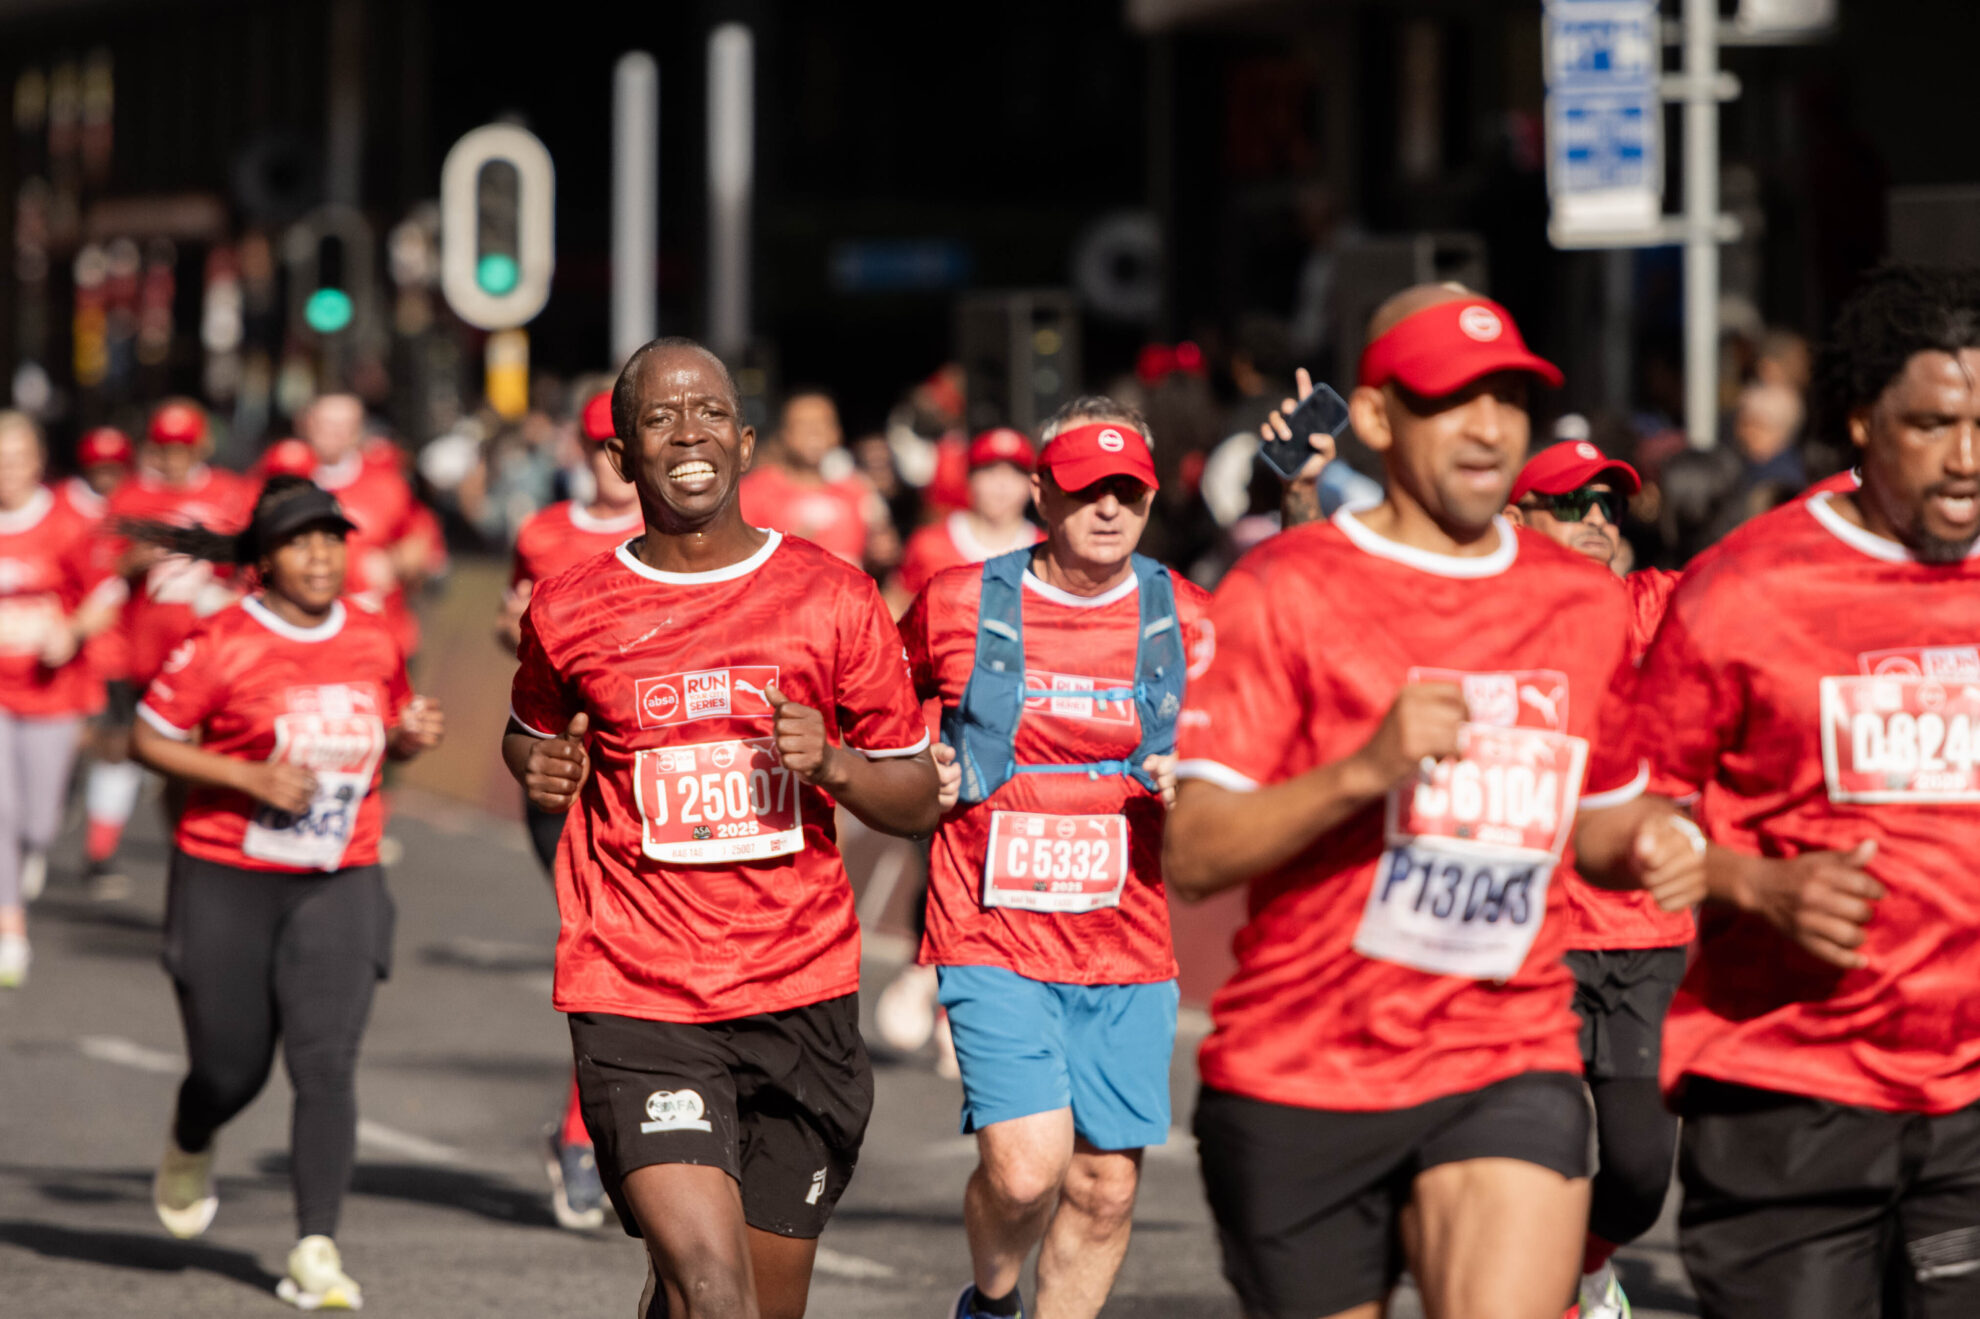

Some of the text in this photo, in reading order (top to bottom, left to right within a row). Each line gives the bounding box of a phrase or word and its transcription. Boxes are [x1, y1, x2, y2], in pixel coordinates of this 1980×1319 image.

[688, 674, 726, 693] RUN
[648, 695, 675, 707] absa
[689, 698, 726, 711] SERIES
[1853, 712, 1980, 774] D824
[694, 820, 760, 838] ASA 2025
